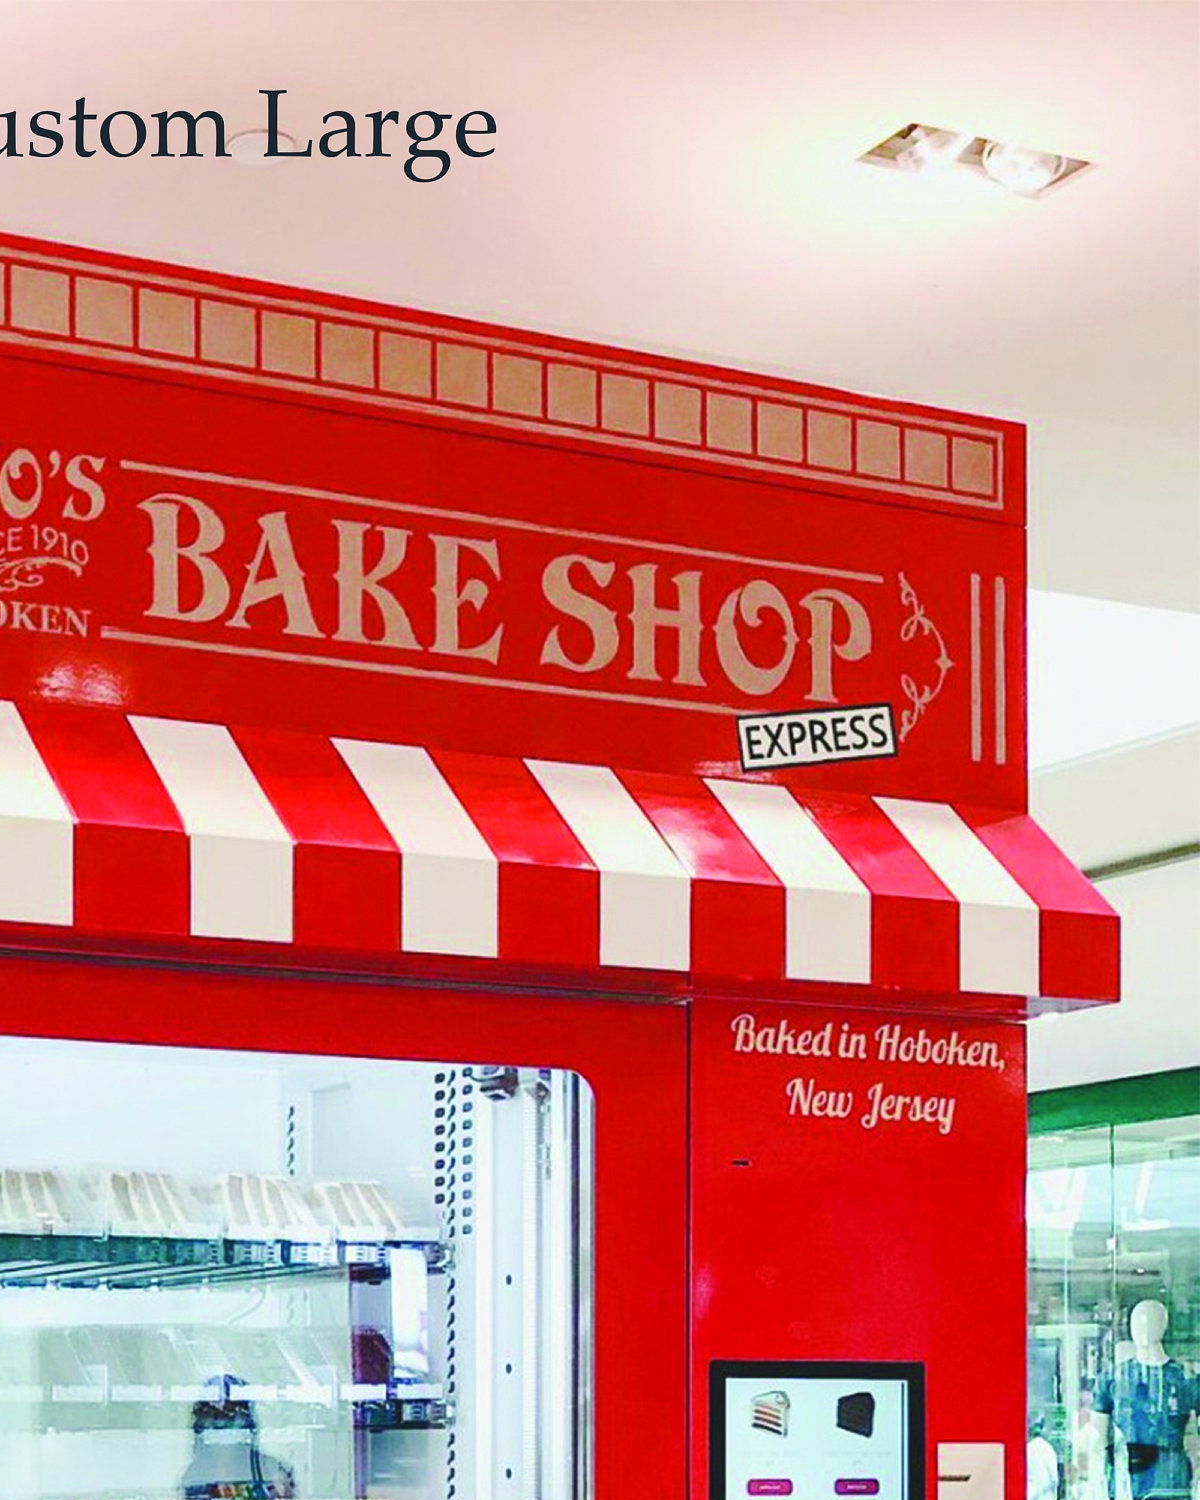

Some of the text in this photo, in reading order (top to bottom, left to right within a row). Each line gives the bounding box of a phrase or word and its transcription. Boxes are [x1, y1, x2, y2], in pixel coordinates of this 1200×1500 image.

[30, 524, 90, 566] 1910
[136, 492, 503, 666] BAKE
[539, 552, 874, 703] SHOP
[746, 712, 890, 760] EXPRESS
[730, 1013, 1007, 1074] Baked in Hoboken,
[785, 1076, 957, 1136] New Jersey
